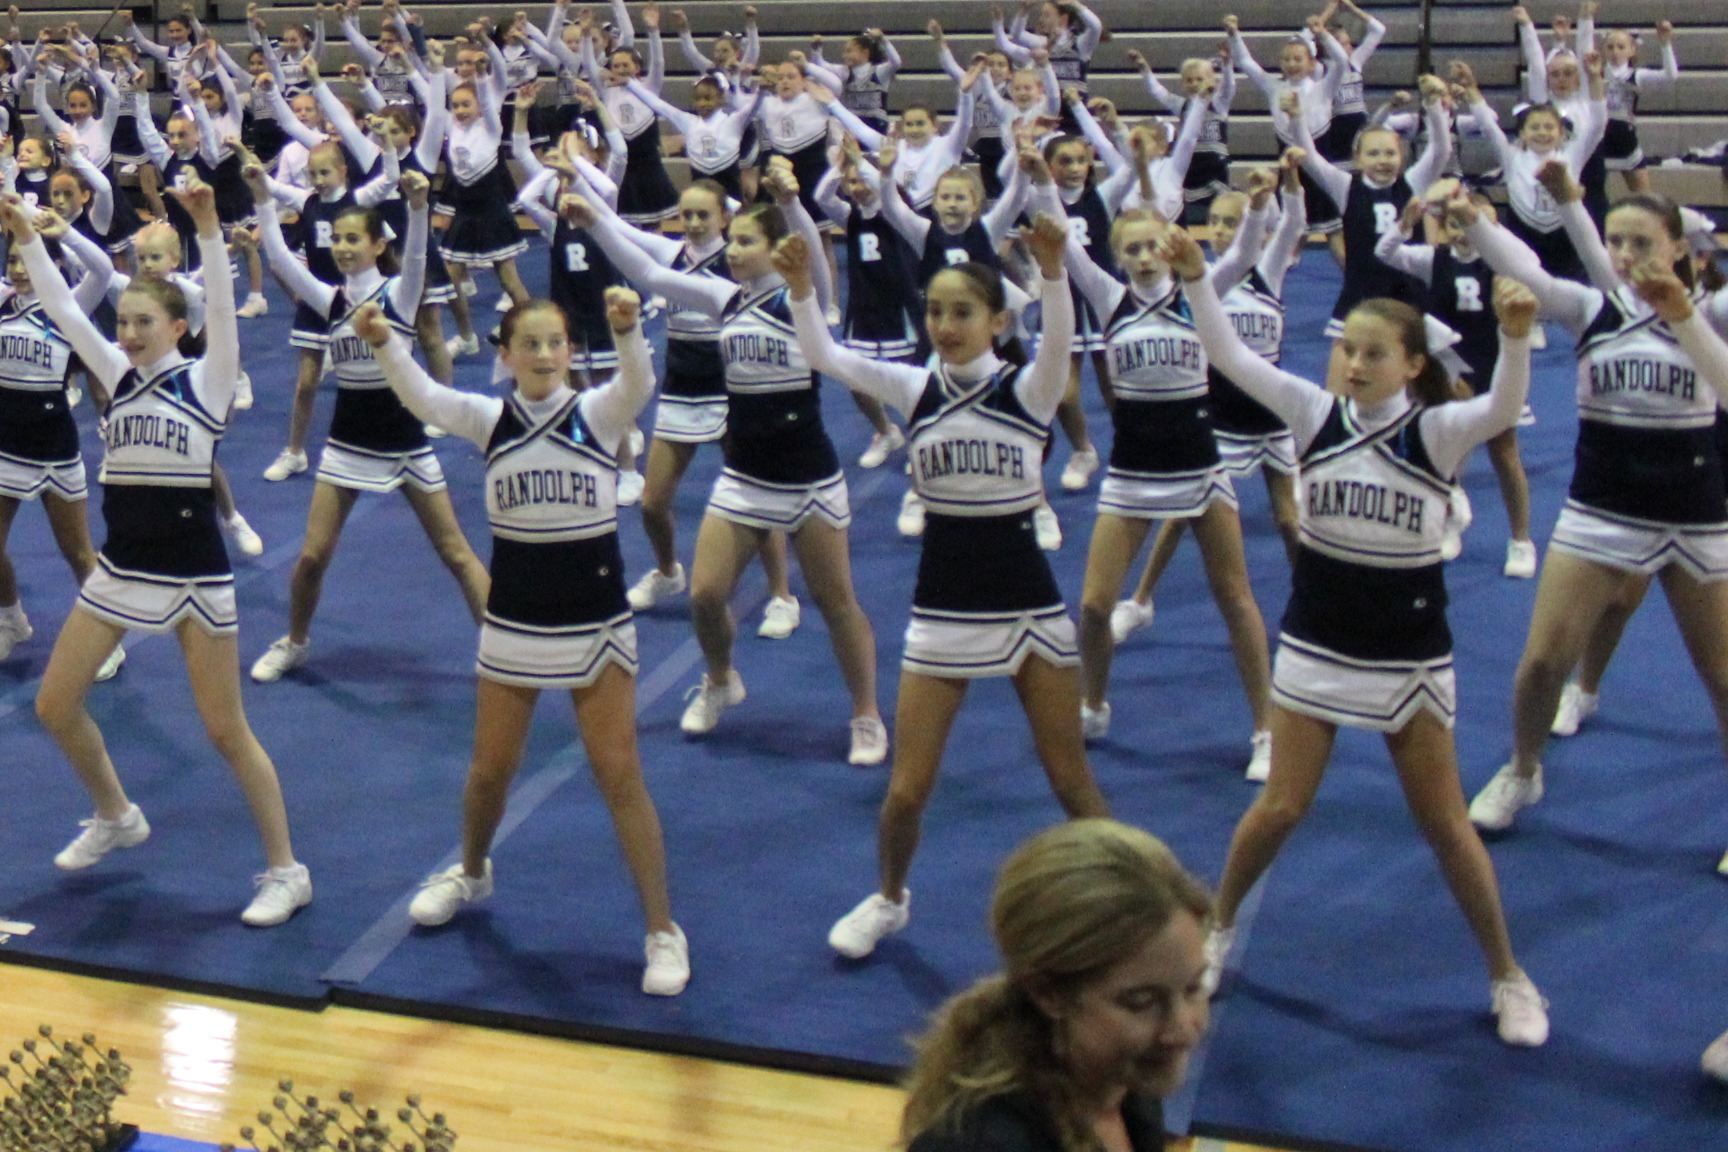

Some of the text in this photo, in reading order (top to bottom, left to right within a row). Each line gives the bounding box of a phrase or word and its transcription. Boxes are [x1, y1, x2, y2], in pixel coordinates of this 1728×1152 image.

[1373, 202, 1398, 234] R
[565, 242, 590, 272] R
[859, 233, 882, 262] R
[1454, 276, 1484, 311] R
[1227, 313, 1277, 341] DOLPH
[722, 334, 790, 368] ANDOLPH
[1115, 337, 1201, 375] RANDOLPH
[1589, 359, 1697, 401] RANDOLPH
[919, 440, 1025, 480] RANDOLPH
[495, 469, 598, 511] RANDOLPH
[1308, 480, 1424, 535] RANDOLPH
